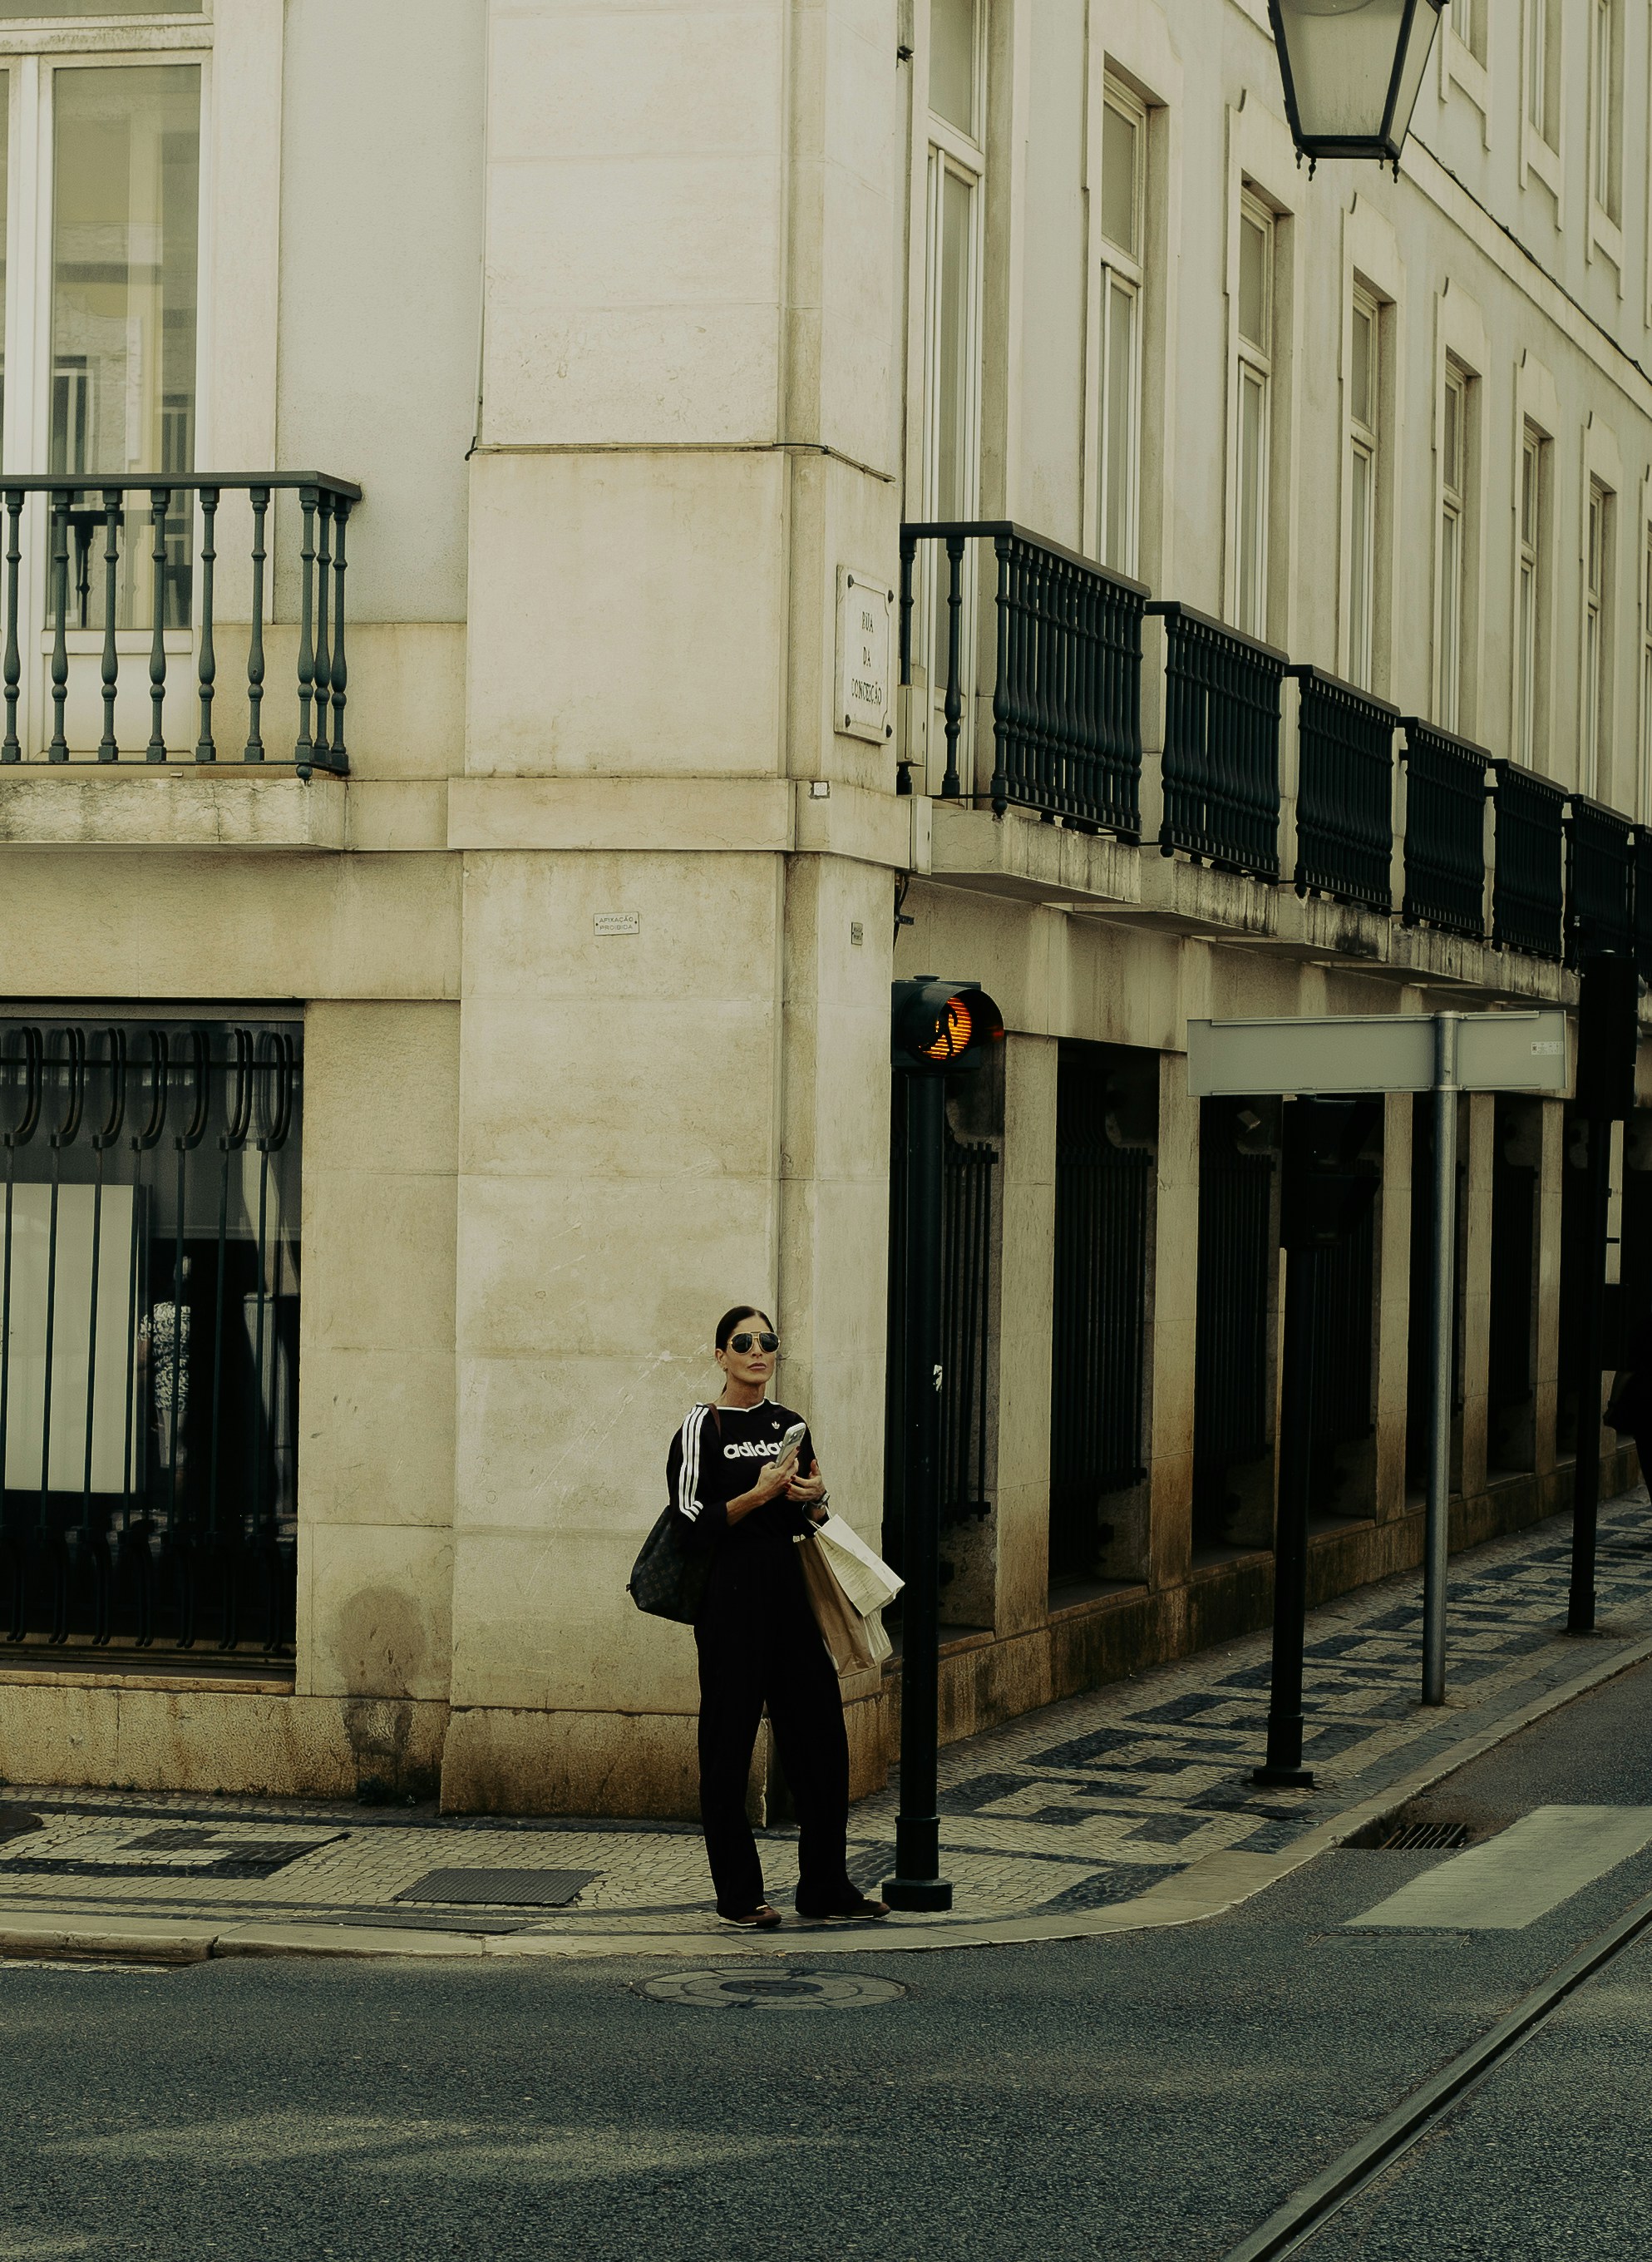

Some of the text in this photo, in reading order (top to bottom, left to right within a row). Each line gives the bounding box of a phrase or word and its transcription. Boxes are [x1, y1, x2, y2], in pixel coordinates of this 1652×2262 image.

[861, 611, 874, 633] RUA
[863, 646, 871, 668] DA
[851, 678, 882, 706] CONCEIÇÃO
[723, 1440, 784, 1459] adida
